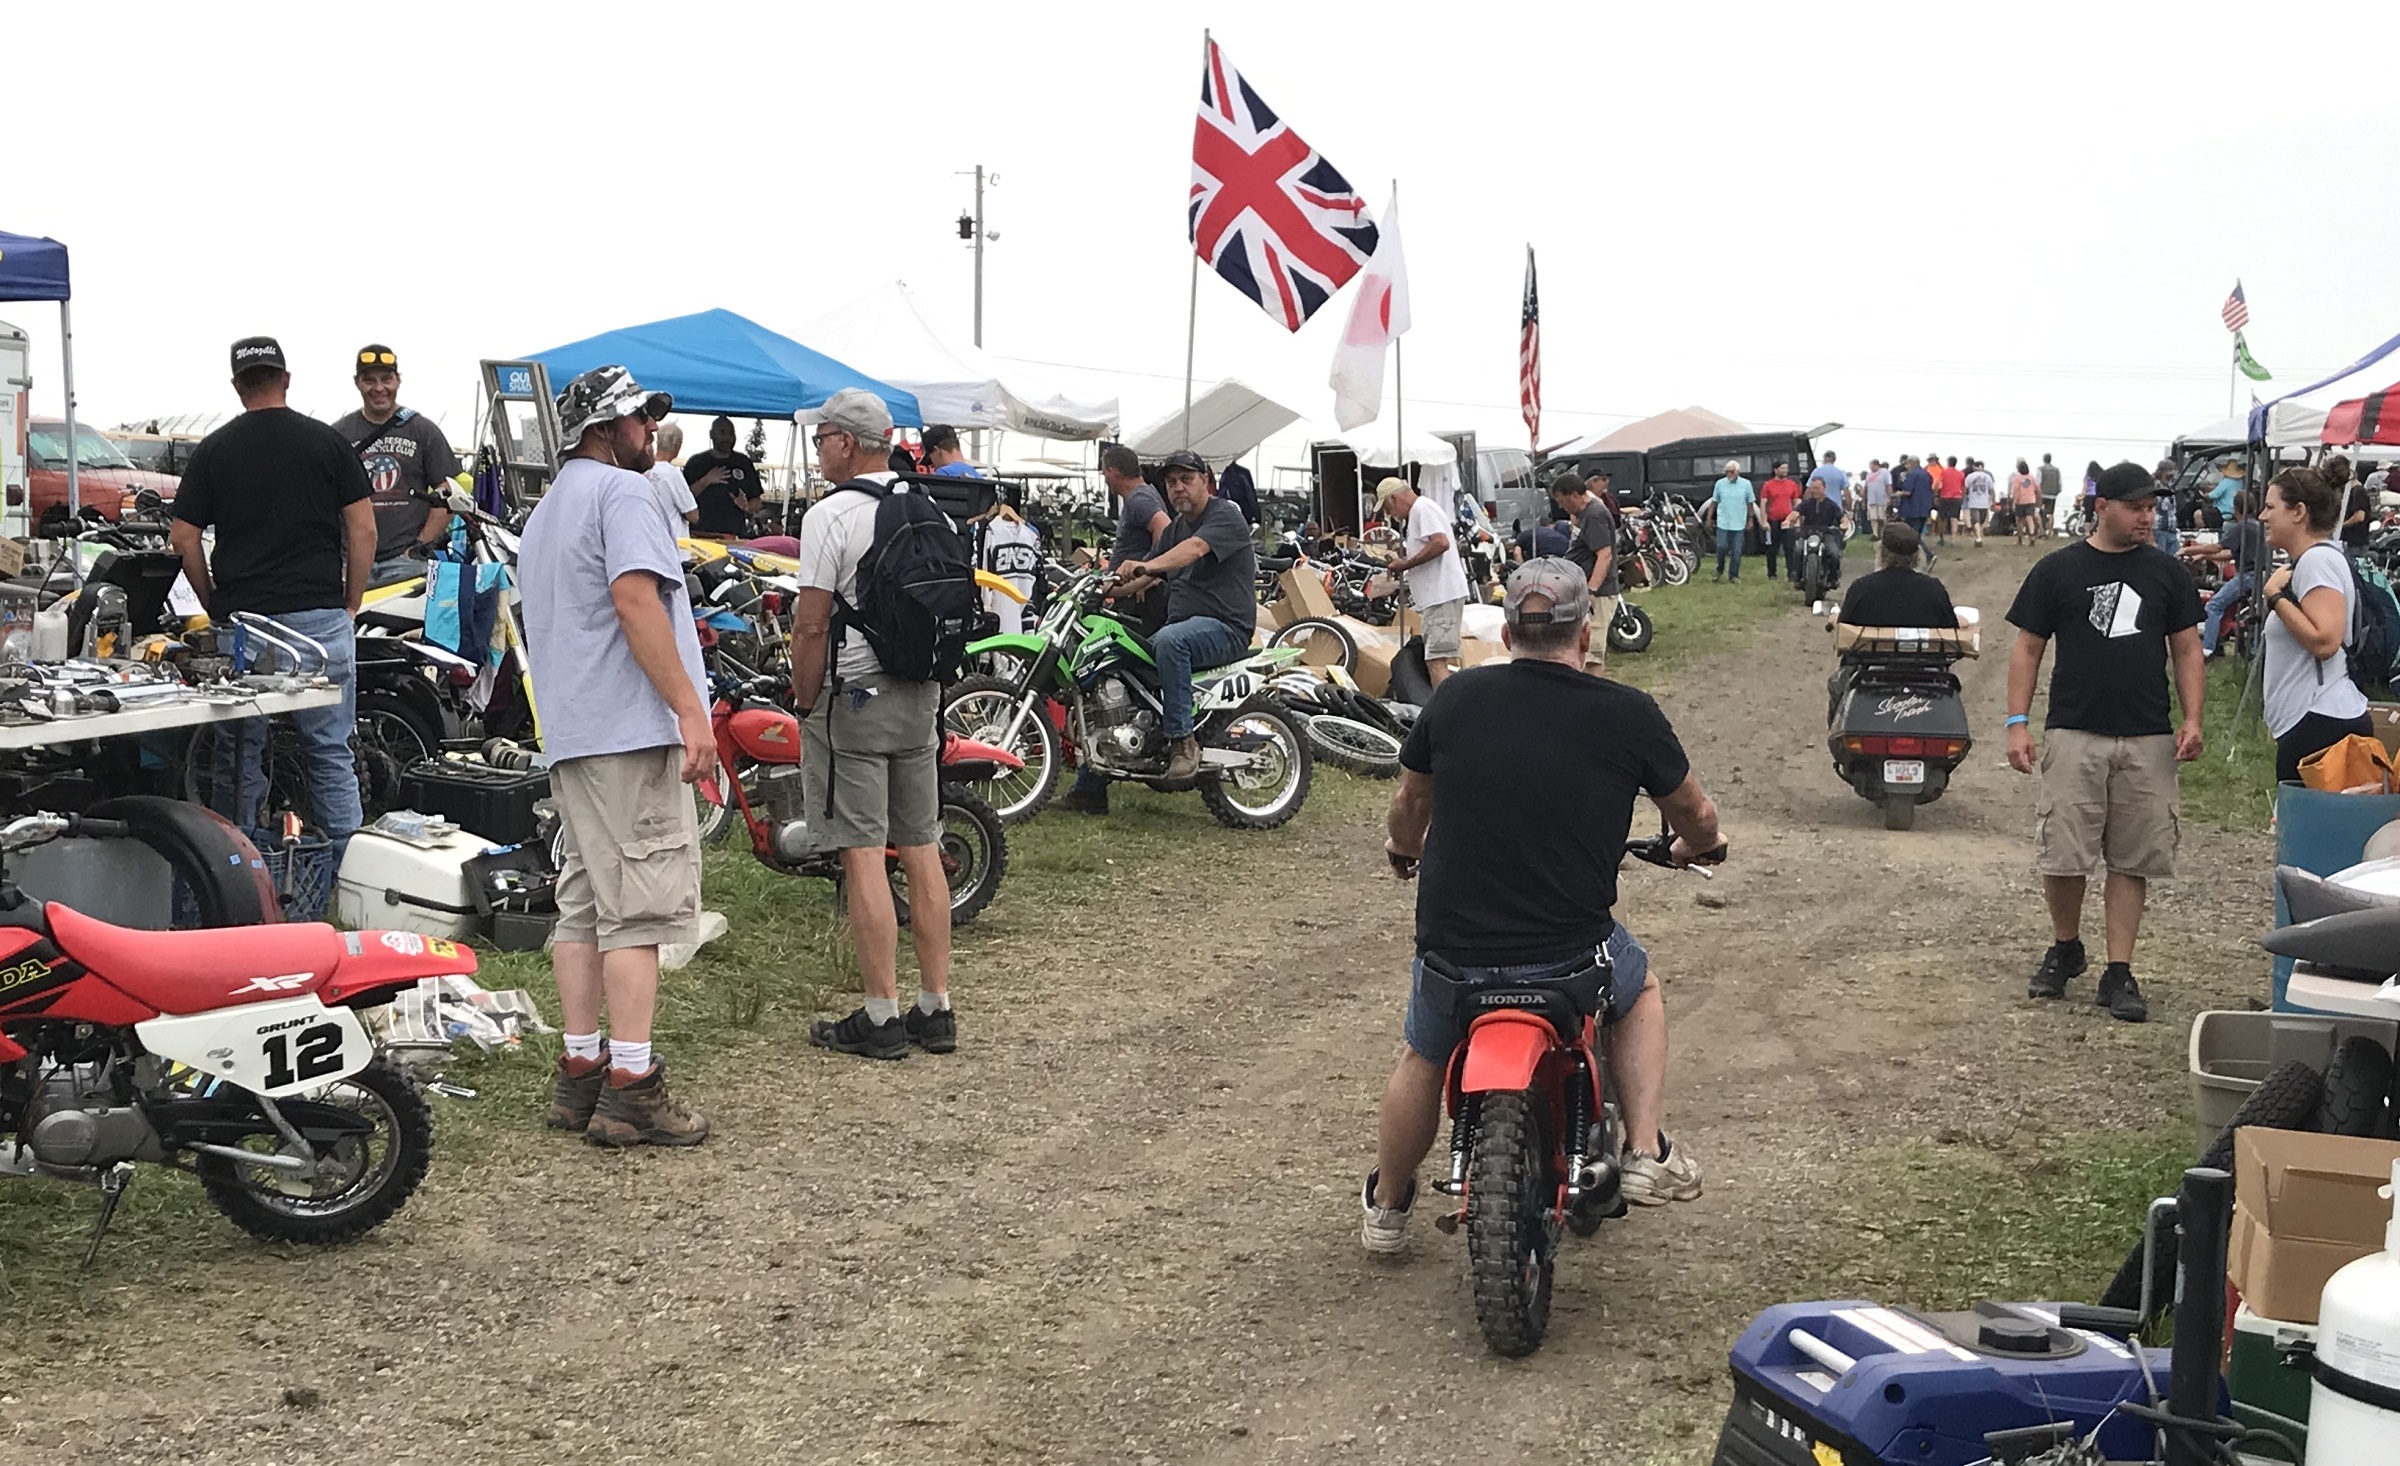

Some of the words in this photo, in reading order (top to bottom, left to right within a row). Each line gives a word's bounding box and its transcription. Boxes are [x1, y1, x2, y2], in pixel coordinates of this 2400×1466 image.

[384, 436, 418, 450] RESERVE
[395, 444, 416, 458] CLUB
[1221, 674, 1251, 703] 40
[228, 972, 315, 996] XR
[1480, 994, 1547, 1005] HONDA
[256, 1014, 319, 1035] GRUNT
[262, 1022, 344, 1091] 12
